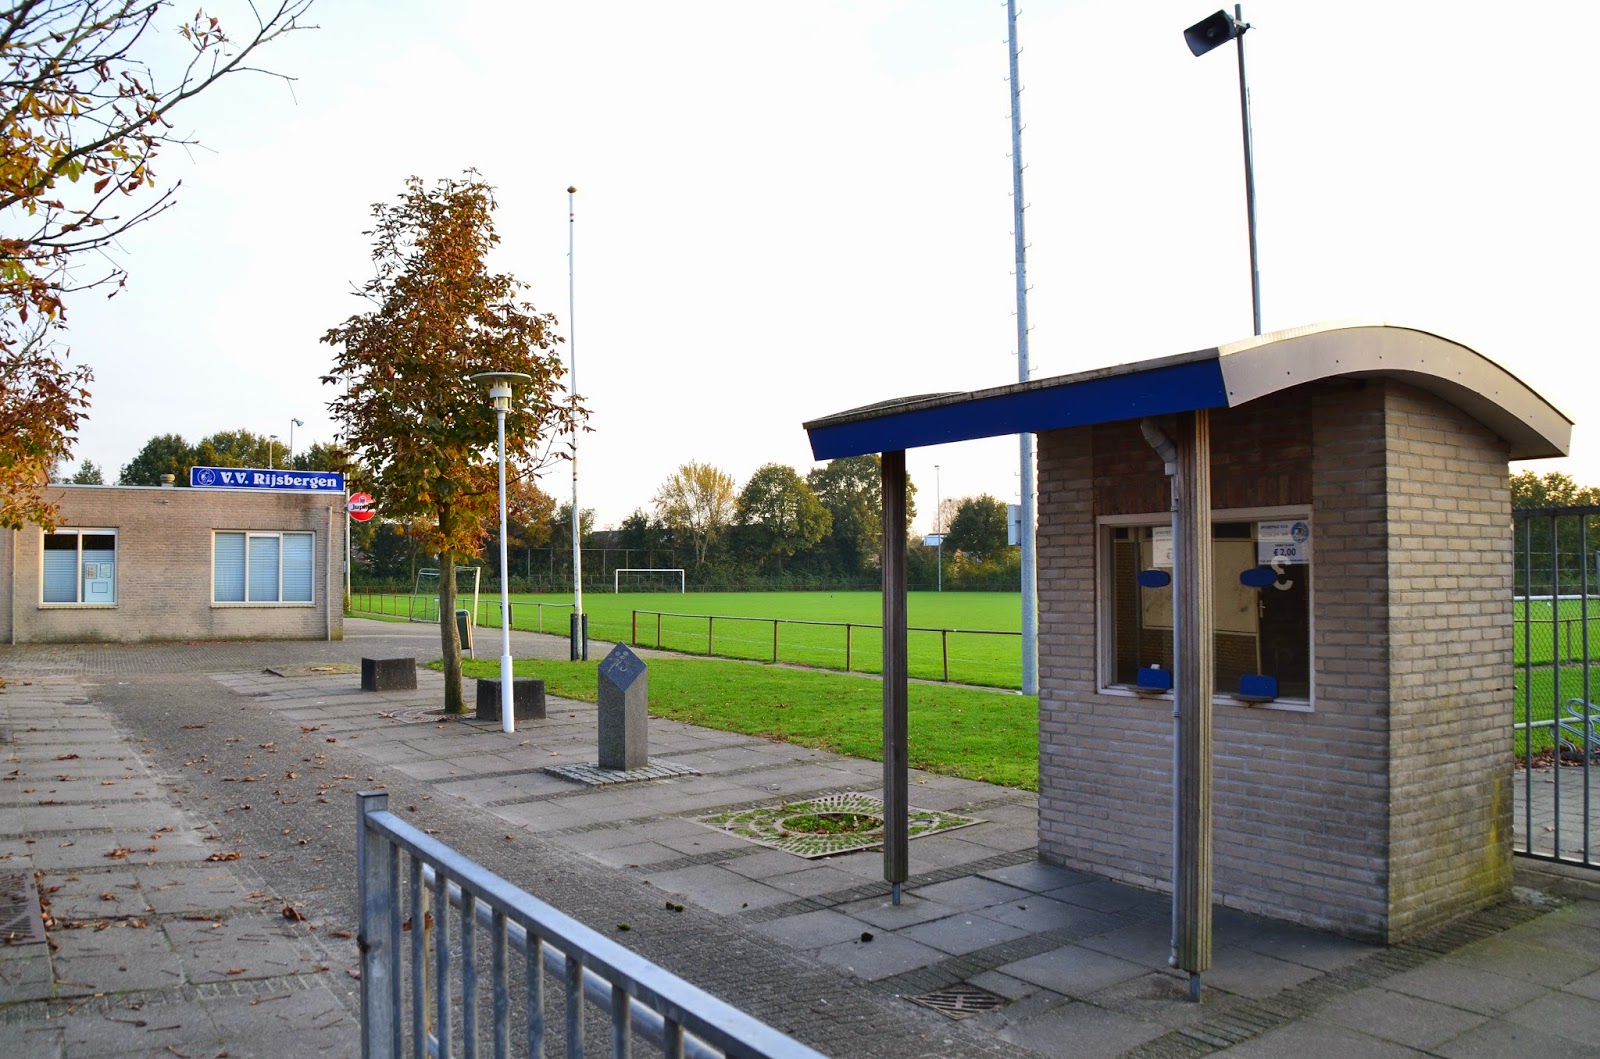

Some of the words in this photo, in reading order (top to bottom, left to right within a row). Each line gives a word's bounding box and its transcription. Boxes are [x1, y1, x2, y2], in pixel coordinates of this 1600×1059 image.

[220, 471, 249, 484] V.V.
[253, 473, 337, 489] Rijsbergen
[1273, 548, 1279, 556] €
[1280, 548, 1296, 556] 2,00
